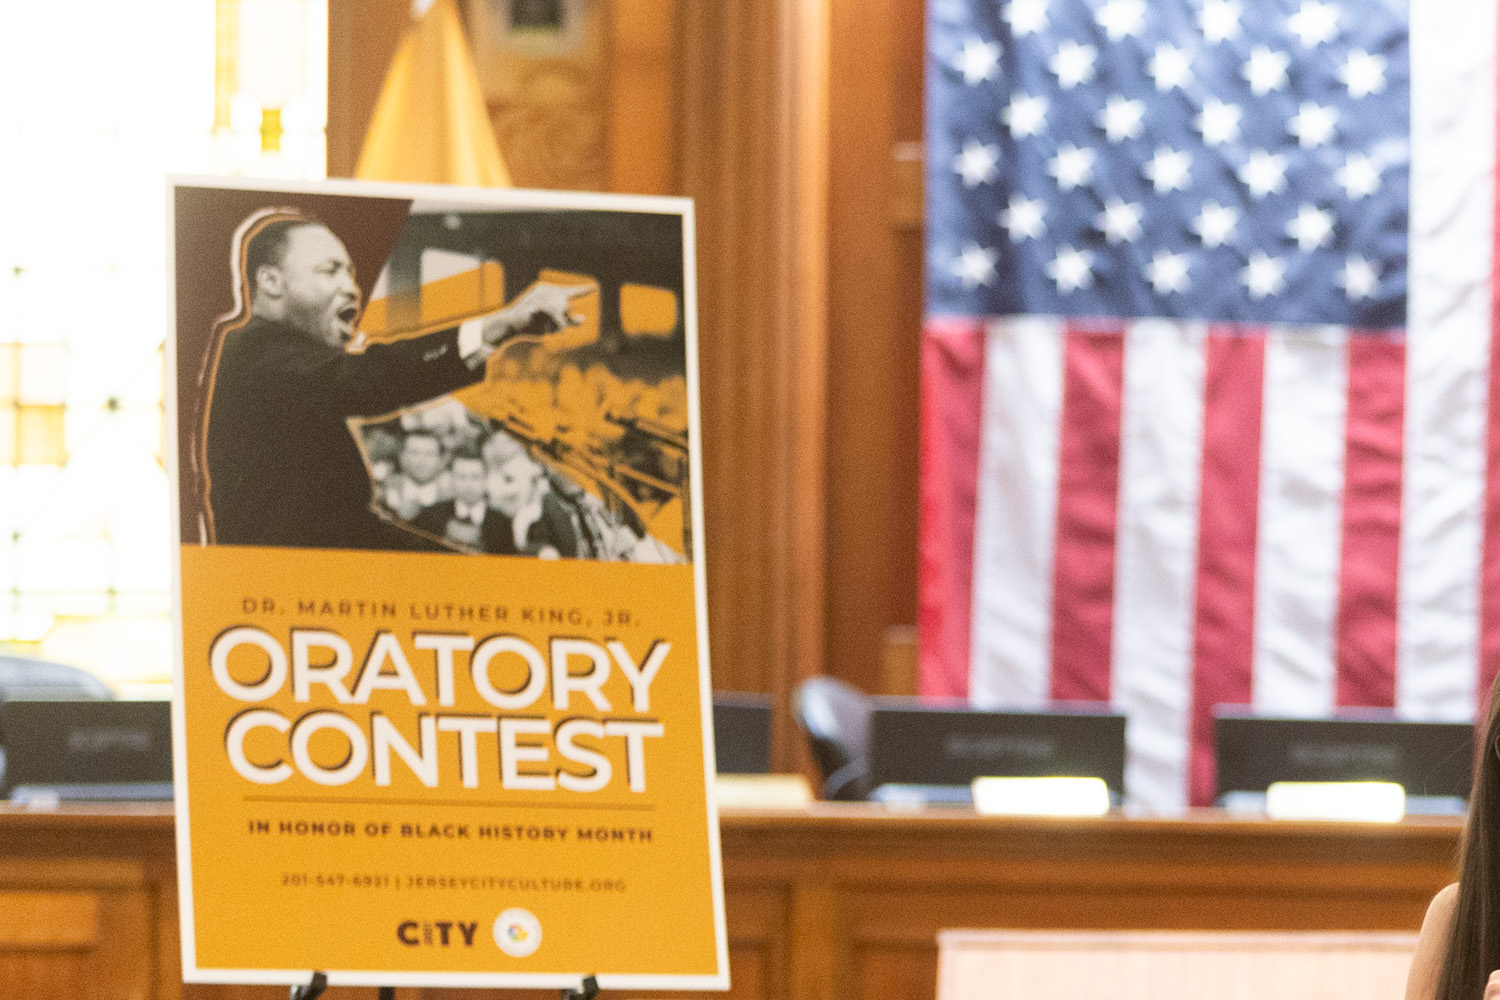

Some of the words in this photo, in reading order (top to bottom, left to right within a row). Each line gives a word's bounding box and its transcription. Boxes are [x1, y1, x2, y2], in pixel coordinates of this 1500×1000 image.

[241, 596, 286, 615] DR.
[298, 599, 398, 619] MARTIN
[410, 602, 509, 623] LUTHER
[521, 606, 594, 628] KING,
[602, 609, 642, 629] JR.
[208, 624, 672, 713] ORATORY
[223, 707, 665, 794] CONTEST
[248, 819, 271, 835] IN
[278, 820, 357, 837] HONOR
[364, 821, 392, 837] OF
[400, 822, 470, 839] BLACK
[478, 825, 568, 841] HISTORY
[576, 827, 653, 843] MONTH
